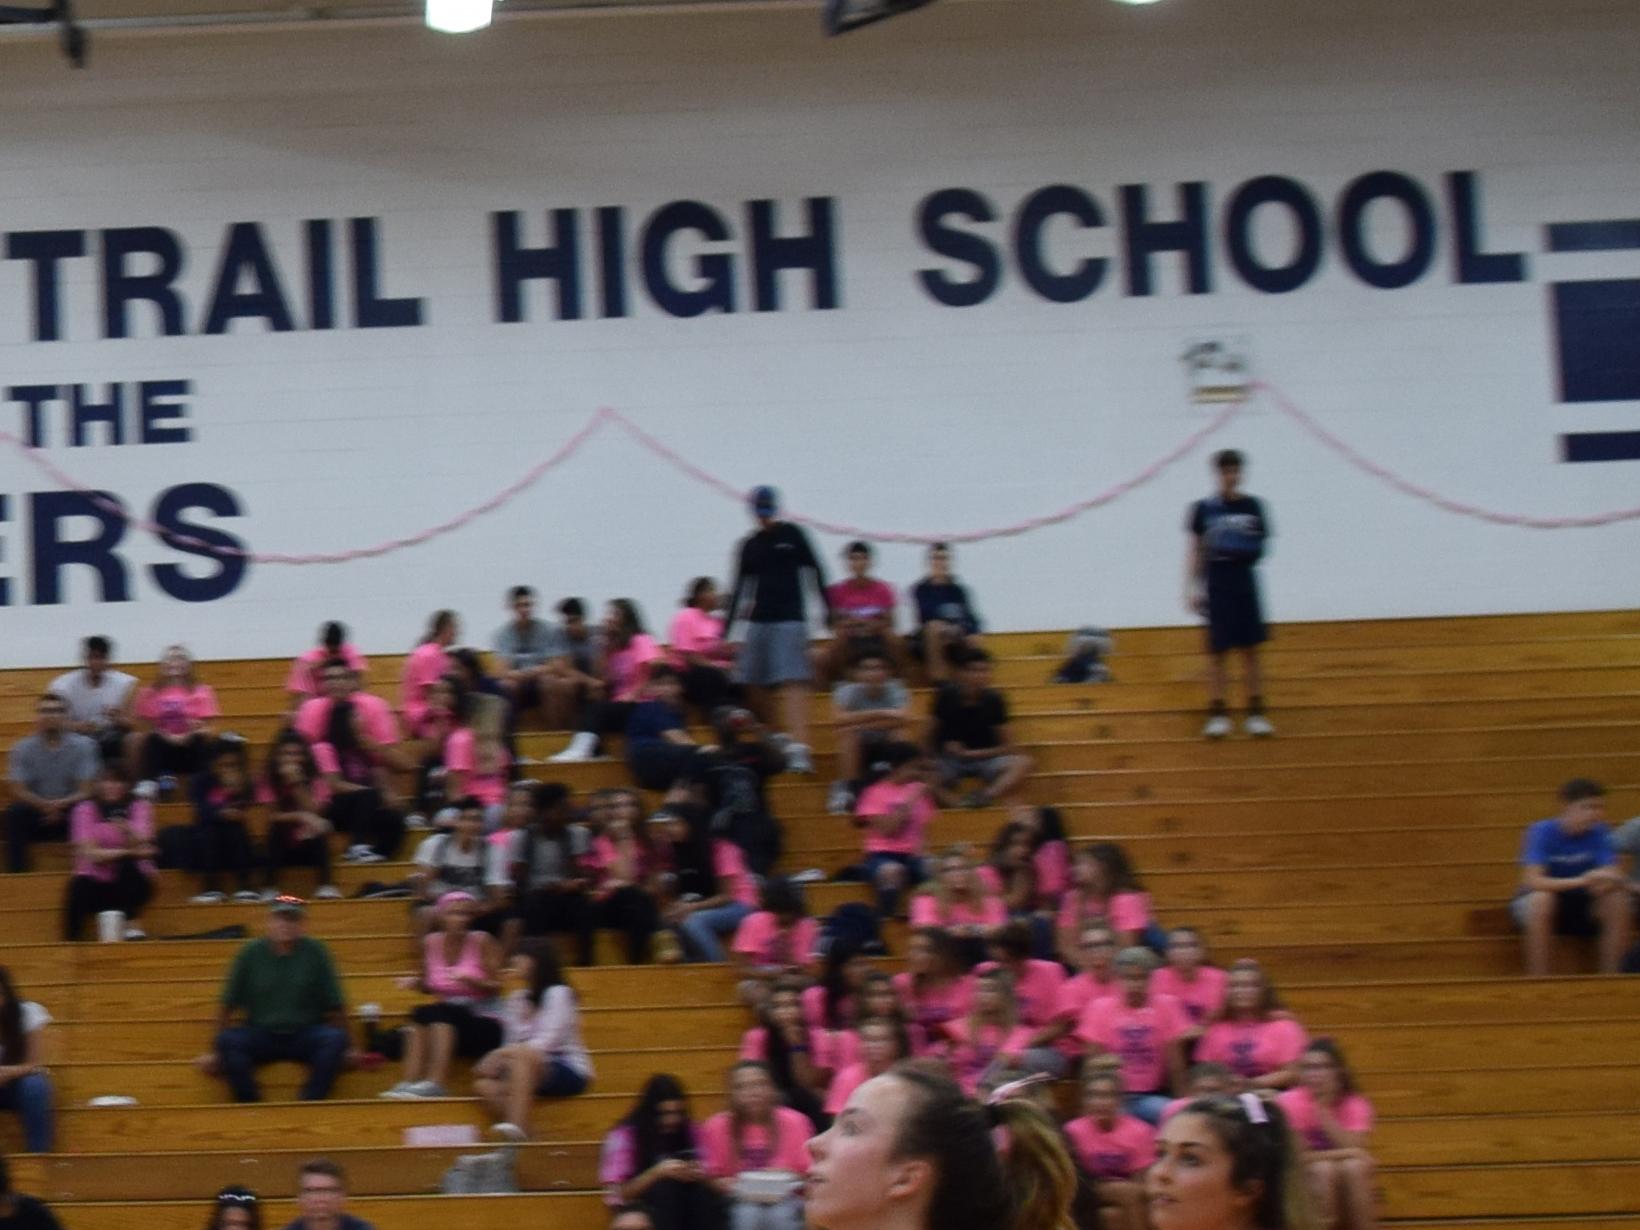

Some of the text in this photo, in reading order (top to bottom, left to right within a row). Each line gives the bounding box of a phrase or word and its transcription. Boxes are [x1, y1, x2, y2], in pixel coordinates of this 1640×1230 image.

[3, 216, 424, 342] TRAIL
[489, 195, 839, 323] HIGH
[914, 169, 1528, 308] SCHOOL
[6, 379, 191, 448] THE
